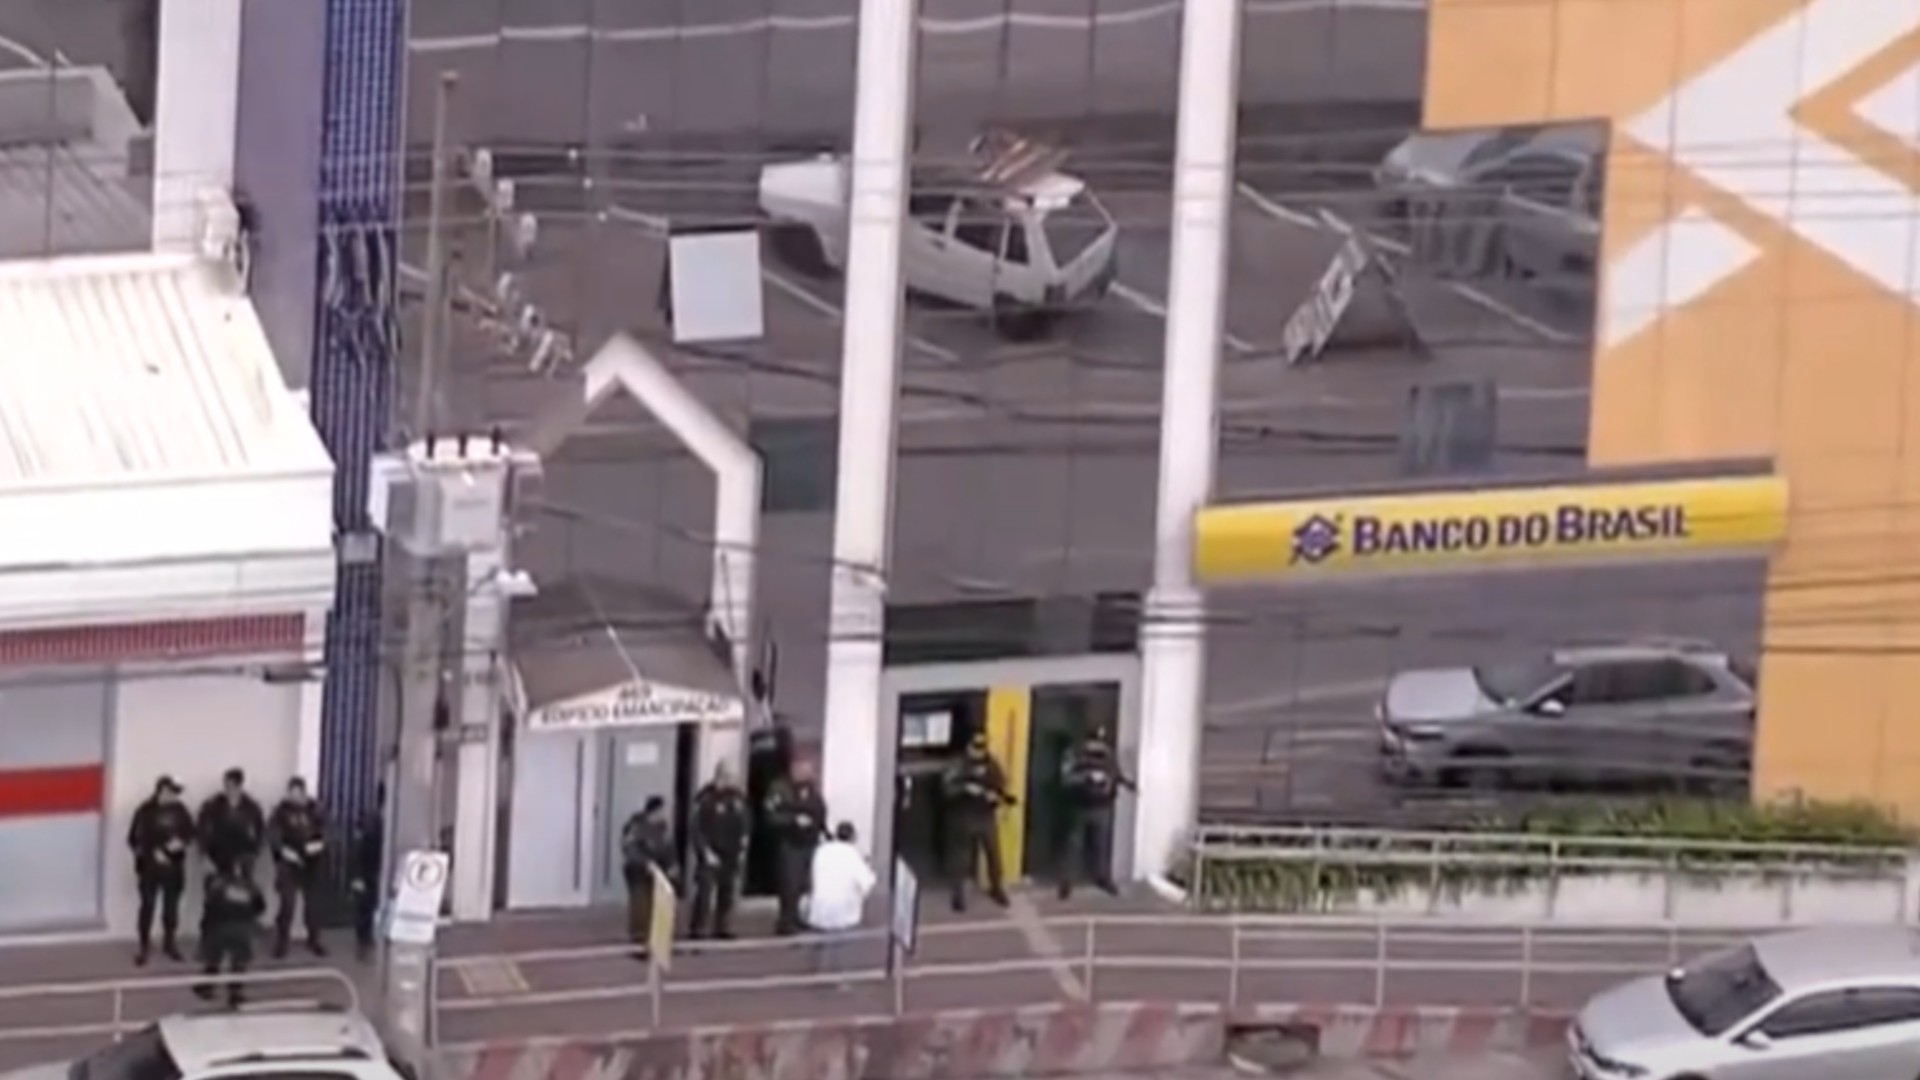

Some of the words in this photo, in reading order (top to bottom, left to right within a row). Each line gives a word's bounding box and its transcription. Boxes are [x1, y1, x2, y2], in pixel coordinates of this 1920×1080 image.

[1352, 513, 1490, 555] BANCO
[1496, 511, 1549, 547] DO
[1555, 504, 1692, 543] BRASIL
